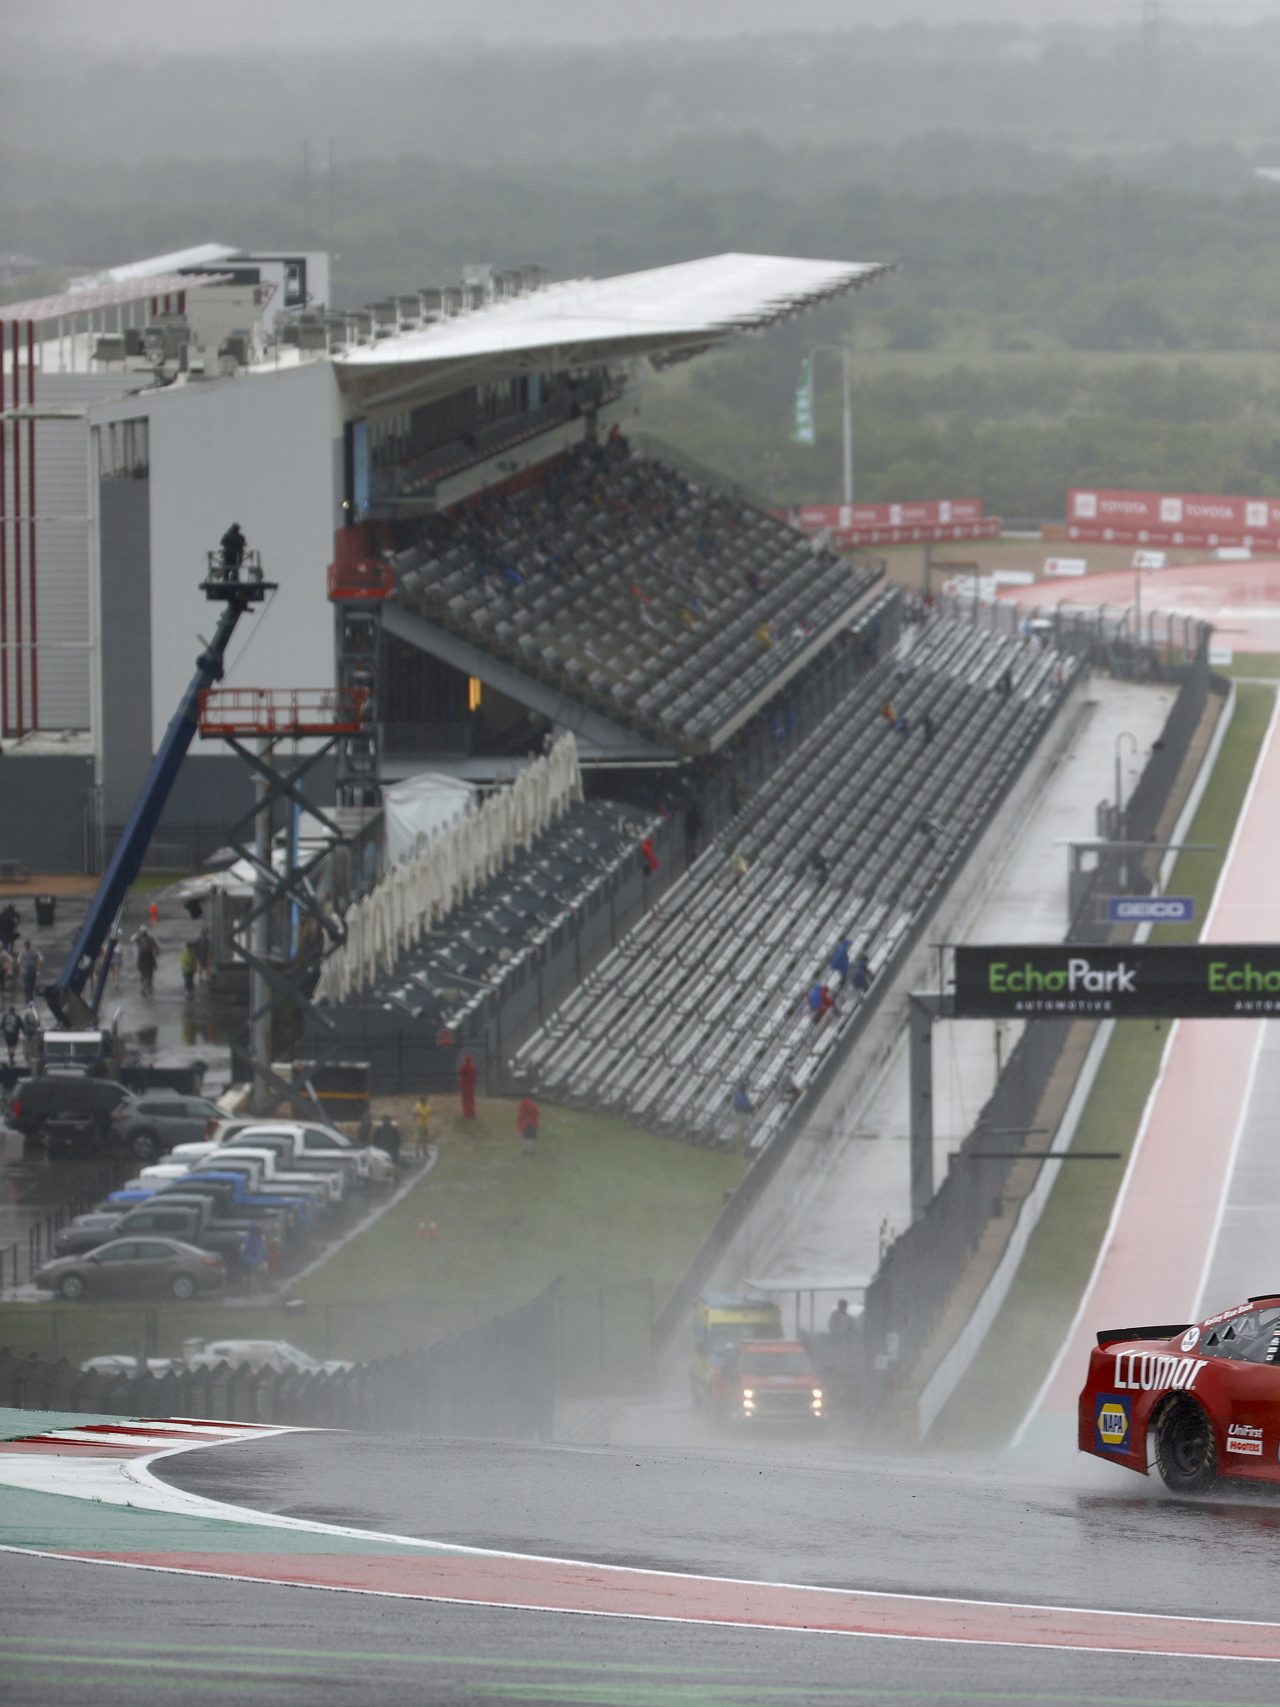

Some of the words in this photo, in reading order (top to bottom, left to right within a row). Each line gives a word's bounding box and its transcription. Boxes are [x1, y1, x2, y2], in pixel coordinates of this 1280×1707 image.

[1101, 501, 1148, 514] TOYOTA
[1187, 504, 1234, 518] TOYOTA
[1117, 902, 1185, 917] GEICO
[989, 958, 1137, 992] EchoPark
[1015, 1001, 1112, 1011] AUTOMOTIVE
[1102, 1413, 1124, 1434] NAPA
[1227, 1424, 1263, 1437] UniFirst
